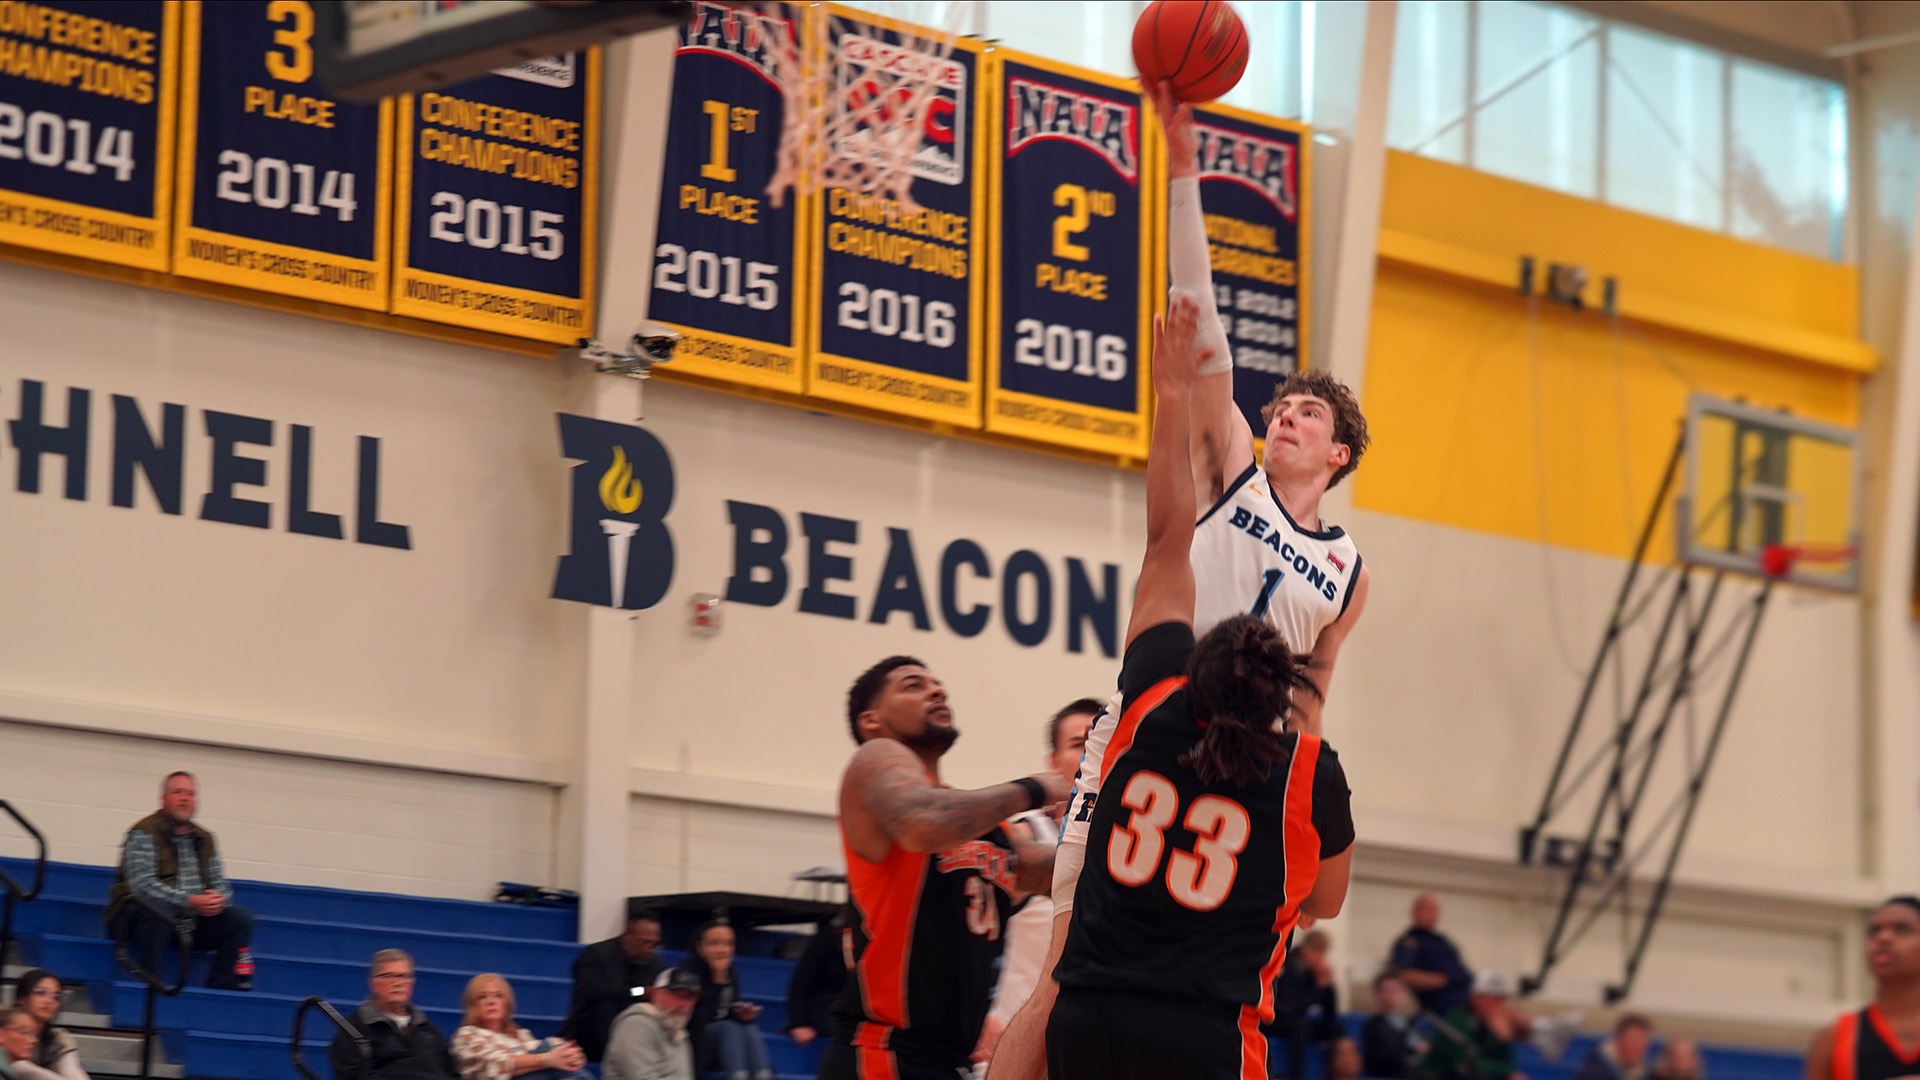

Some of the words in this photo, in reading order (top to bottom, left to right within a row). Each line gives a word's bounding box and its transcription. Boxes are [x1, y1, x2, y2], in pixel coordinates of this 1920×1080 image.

[678, 3, 786, 80] AIA
[244, 86, 335, 128] PLACE
[421, 92, 579, 151] CONFERENCE
[1010, 80, 1133, 172] NAIA
[0, 104, 134, 181] 2014
[420, 128, 578, 189] CHAMPIONS
[217, 150, 357, 222] 2014
[679, 185, 759, 225] PLACE
[430, 191, 564, 260] 2015
[828, 222, 967, 279] CHAMPIONS
[654, 243, 779, 311] 2015
[1036, 264, 1108, 300] PLACE
[838, 281, 956, 348] 2016
[1015, 318, 1127, 381] 2016
[0, 378, 413, 550] HNELL
[725, 499, 1140, 659] BEACON
[1229, 505, 1338, 602] BEACONS
[1251, 568, 1285, 621] 1
[1107, 770, 1251, 912] 33
